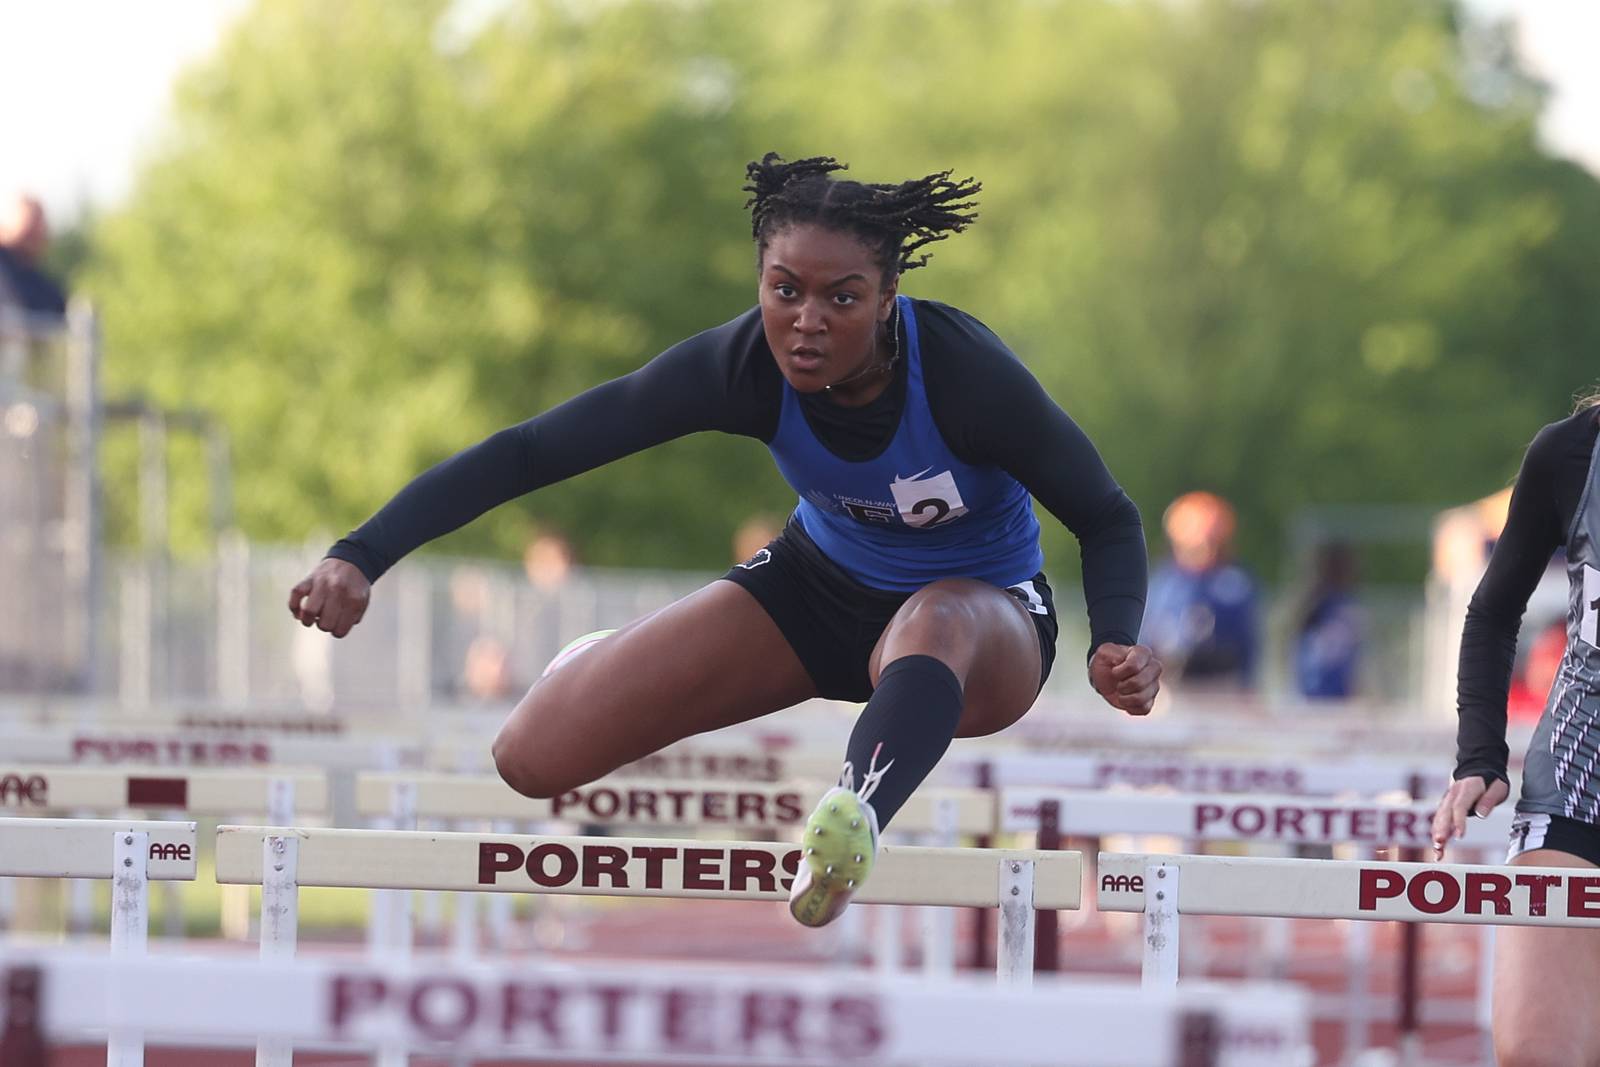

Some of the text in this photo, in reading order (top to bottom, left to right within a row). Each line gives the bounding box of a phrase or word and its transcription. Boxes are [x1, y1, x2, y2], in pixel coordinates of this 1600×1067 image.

[911, 498, 950, 528] 2
[549, 786, 804, 826] PORTERS
[1194, 803, 1438, 841] PORTER
[1358, 868, 1600, 919] PORTE
[327, 974, 884, 1060] PORTERS
